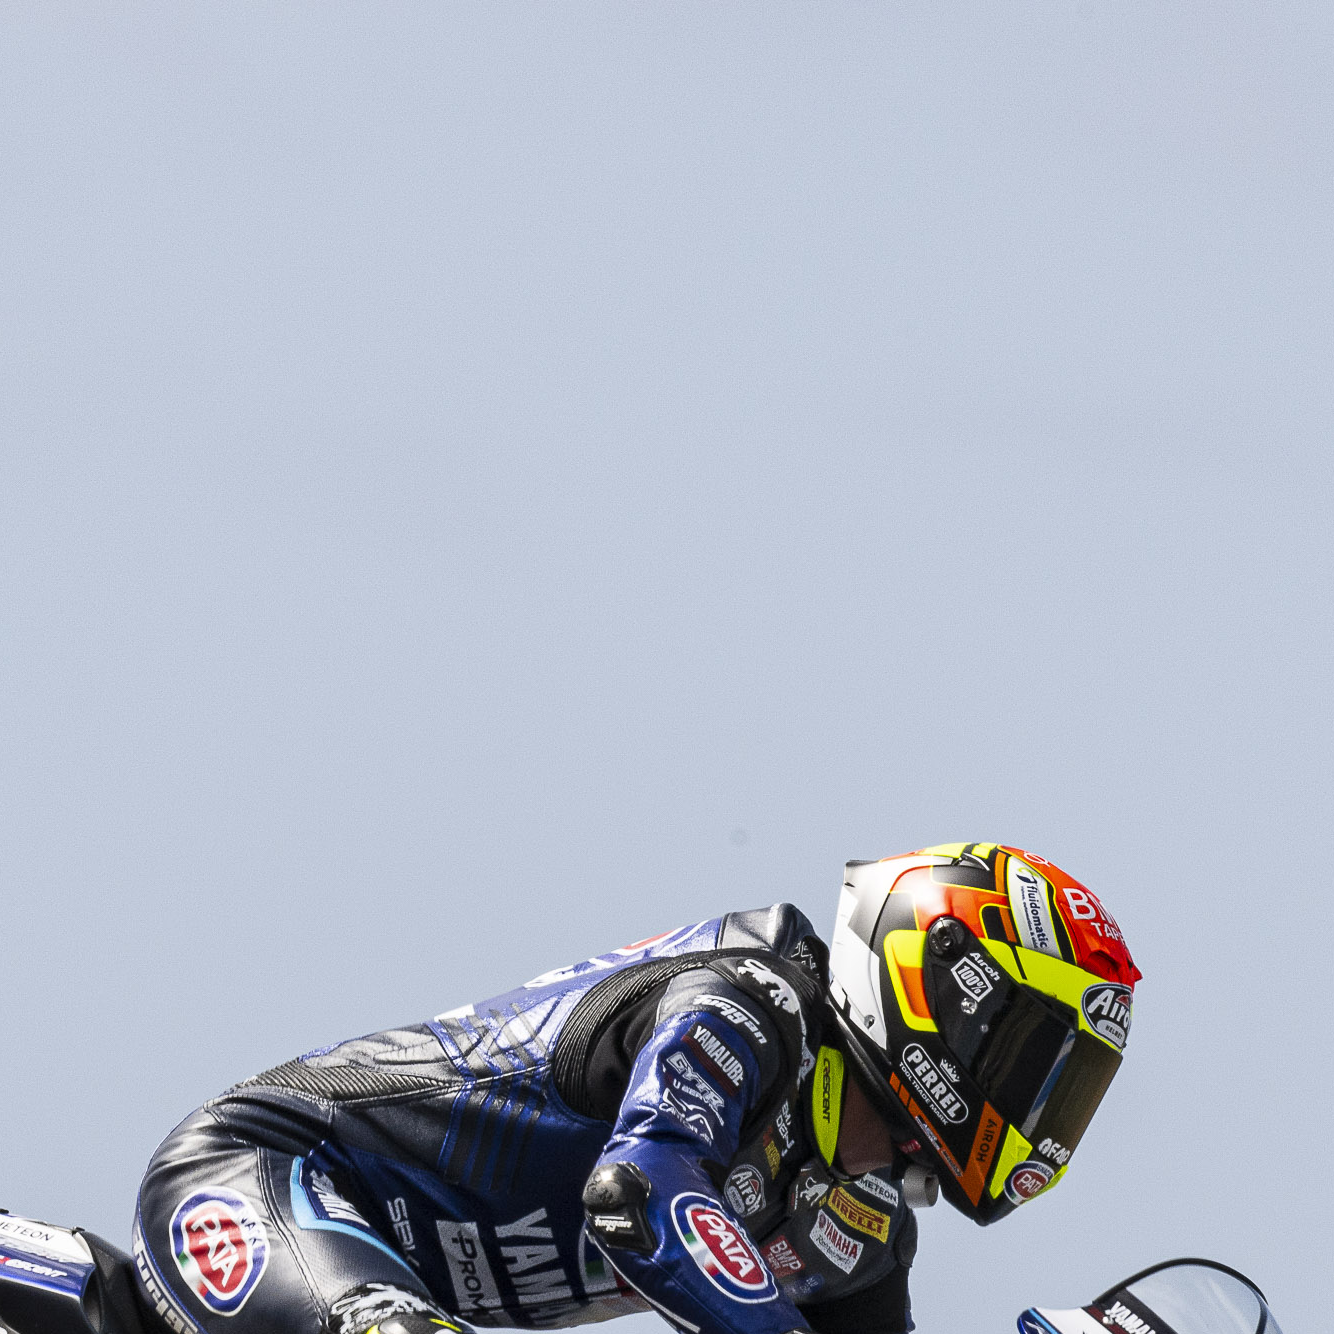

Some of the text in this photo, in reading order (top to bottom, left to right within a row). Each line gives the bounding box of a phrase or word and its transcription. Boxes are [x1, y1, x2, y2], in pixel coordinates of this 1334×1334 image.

[1027, 885, 1048, 948] fluidomatic
[957, 965, 987, 994] 100%
[969, 952, 1000, 981] Airoh
[666, 1051, 725, 1108] GYTR
[693, 1025, 744, 1086] YAMALUBE
[907, 1049, 957, 1118] PERREL
[821, 1057, 831, 1123] CRESCENT
[899, 1061, 912, 1081] TOOL
[911, 1080, 931, 1104] TRADE
[930, 1103, 948, 1125] MARK
[976, 1119, 997, 1162] AIROH
[833, 1189, 884, 1234] PIRELLI
[860, 1178, 898, 1201] METEON
[192, 1213, 239, 1287] PATA
[696, 1213, 755, 1278] PATA
[770, 1240, 801, 1270] BMP
[824, 1220, 857, 1259] YAMAHA
